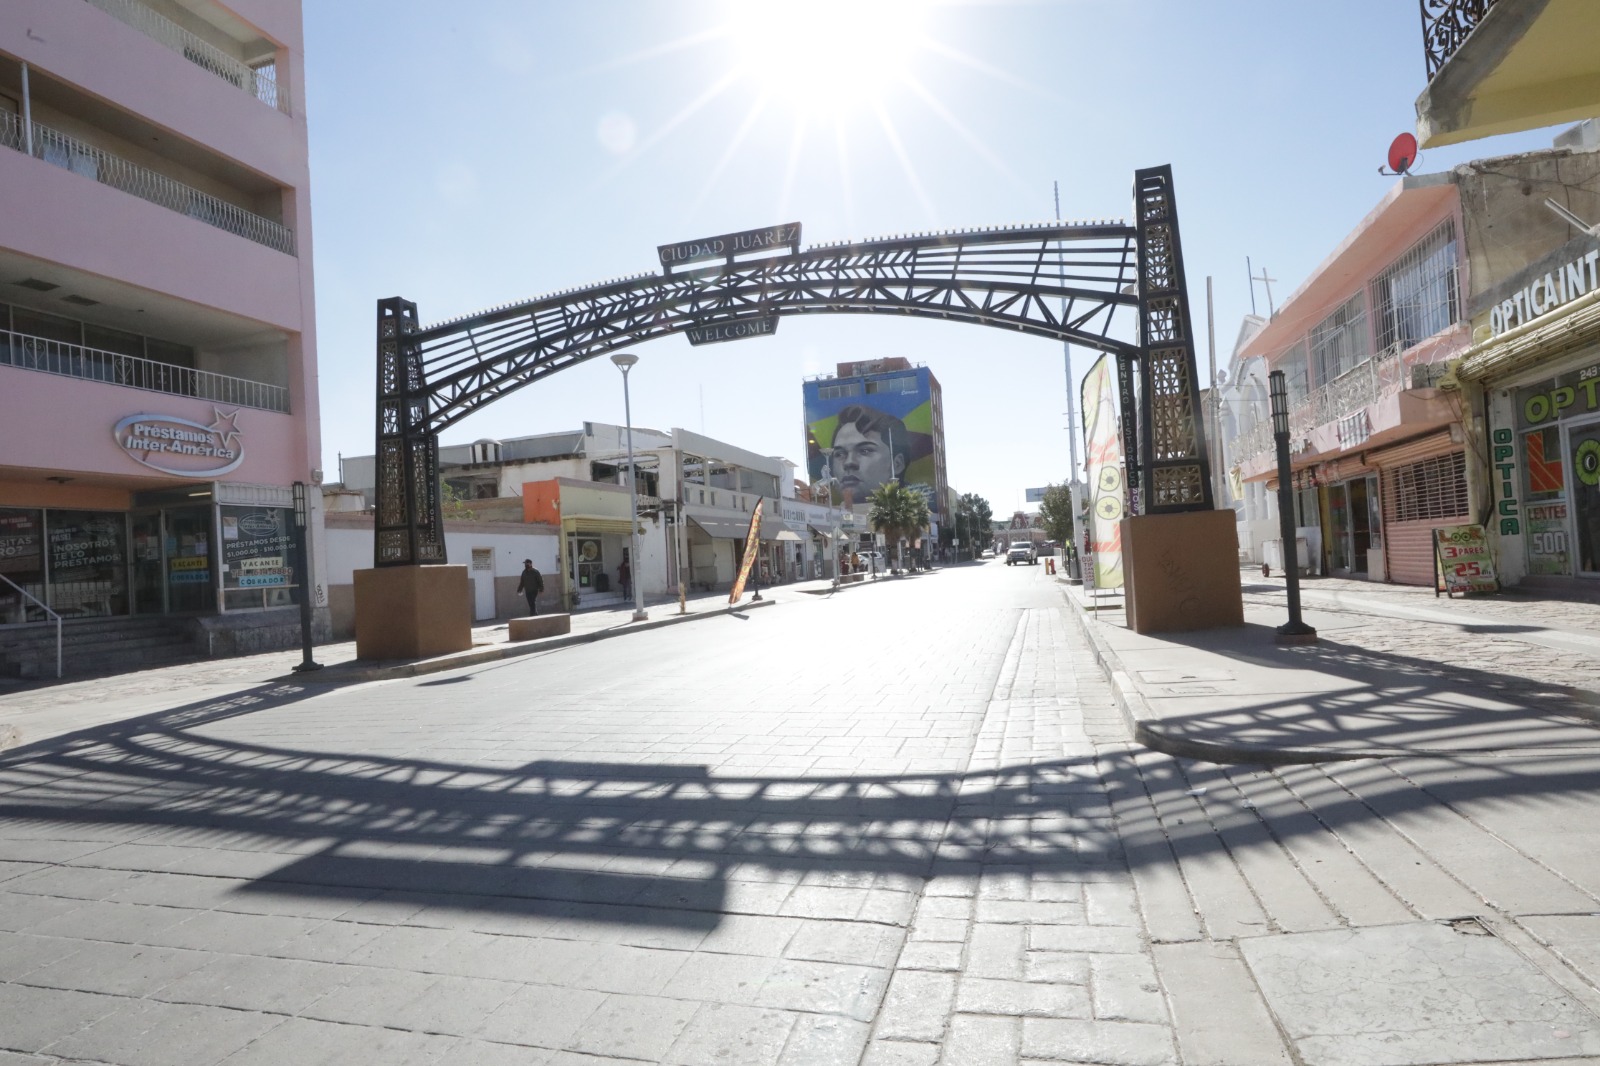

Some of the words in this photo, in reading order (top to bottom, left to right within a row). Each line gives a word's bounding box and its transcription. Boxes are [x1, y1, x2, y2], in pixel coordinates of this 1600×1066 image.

[660, 239, 725, 263] CIUDAD
[733, 226, 798, 251] JUAREZ
[690, 319, 771, 342] WELCOME
[1119, 355, 1130, 404] CENTRO
[1580, 366, 1598, 380] 243
[133, 423, 215, 444] Préstamos
[126, 435, 235, 459] Inter-América
[1494, 428, 1520, 535] OPTICA
[1444, 547, 1458, 558] 3
[1458, 547, 1485, 555] PARES
[1532, 530, 1567, 554] 500
[53, 552, 68, 561] TE
[70, 550, 85, 559] LO
[242, 560, 280, 568] VACANTE
[1454, 561, 1481, 577] 25
[240, 577, 284, 585] COBRADOR
